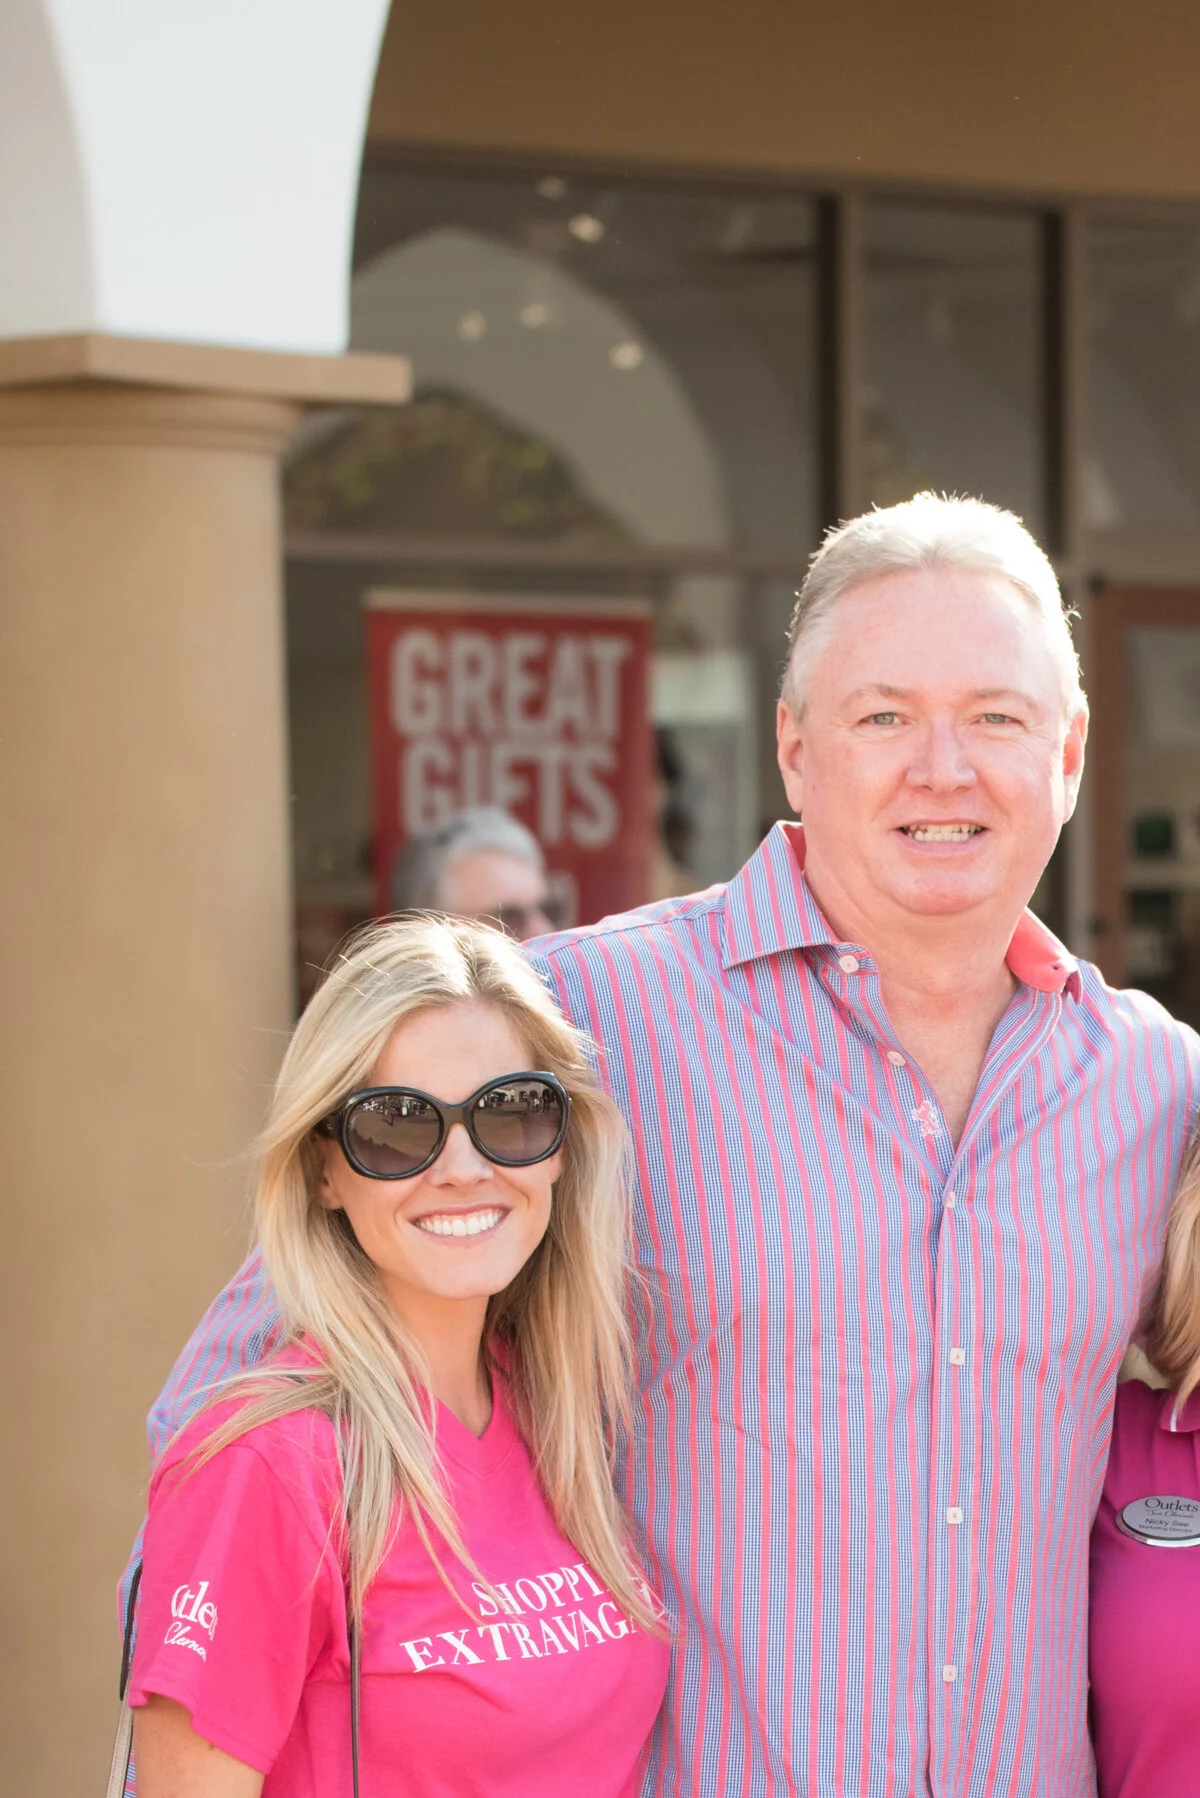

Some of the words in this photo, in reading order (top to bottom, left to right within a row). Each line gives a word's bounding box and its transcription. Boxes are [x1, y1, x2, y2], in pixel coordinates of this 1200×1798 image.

[392, 629, 633, 738] GREAT
[402, 738, 618, 846] GIFTS
[1144, 1497, 1199, 1512] Outlets
[471, 1562, 651, 1617] SHOPPI
[400, 1601, 637, 1674] EXTRAVAG
